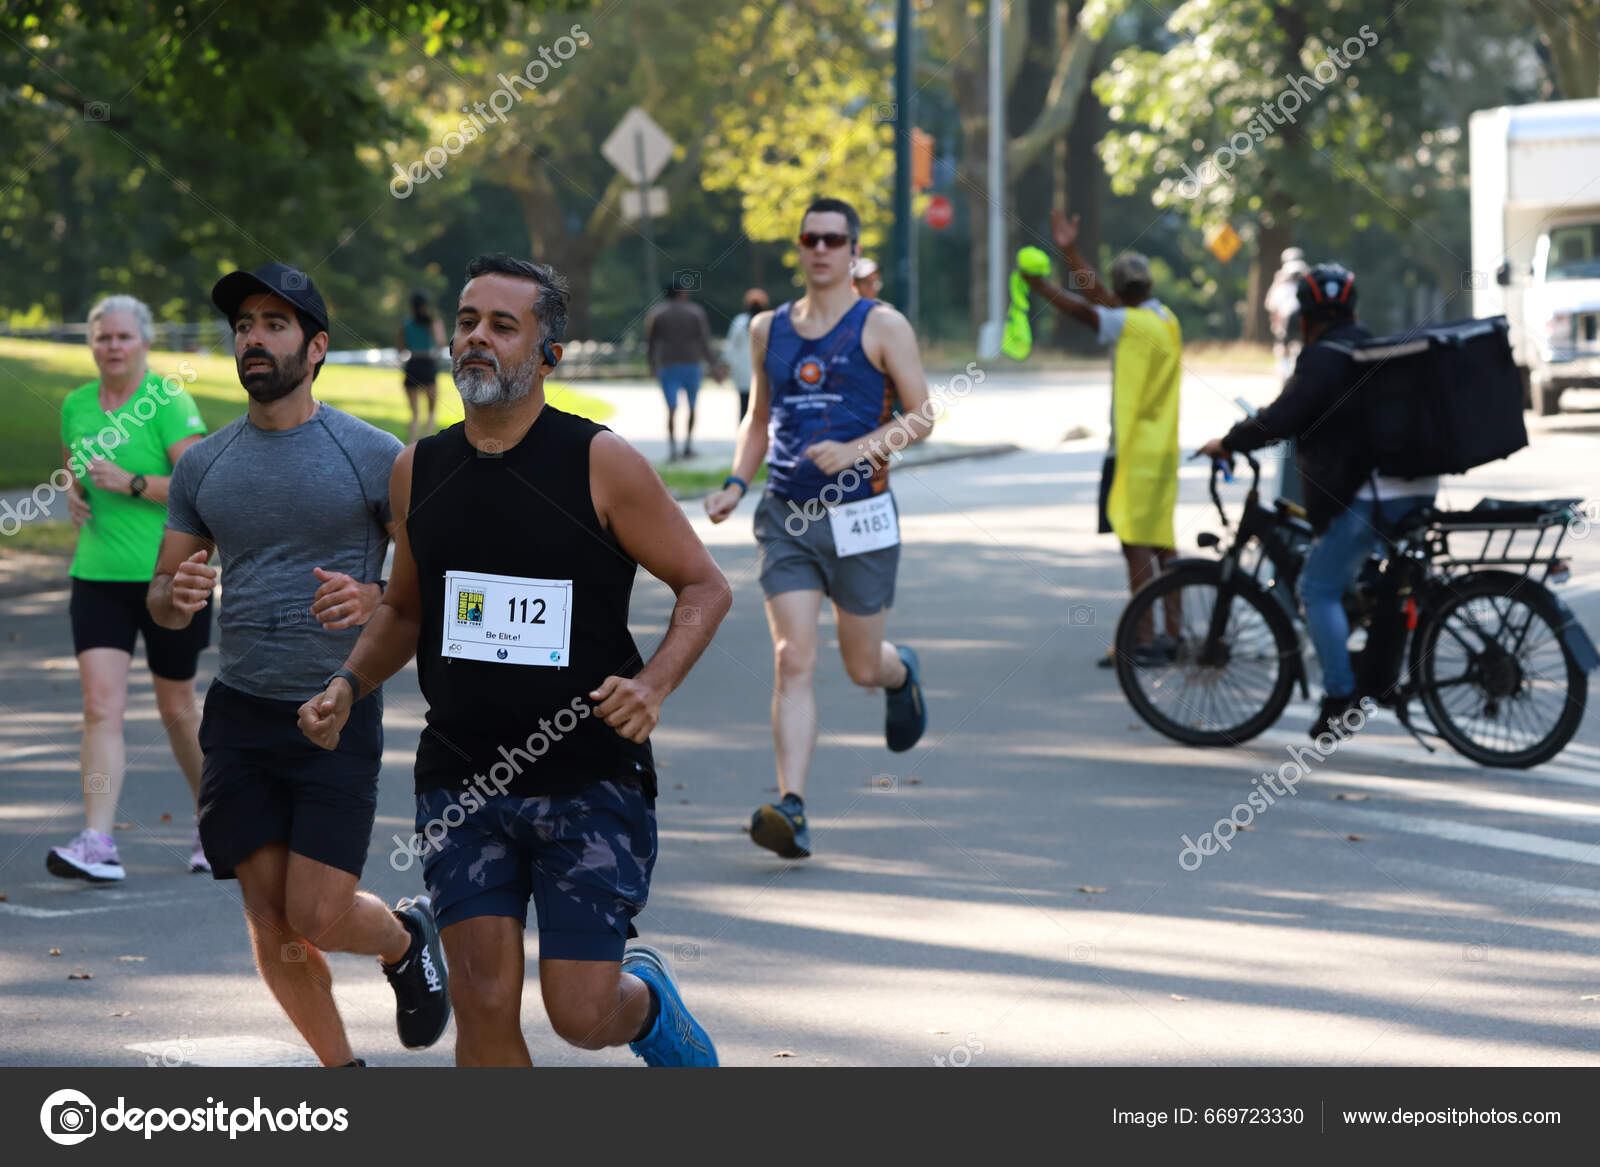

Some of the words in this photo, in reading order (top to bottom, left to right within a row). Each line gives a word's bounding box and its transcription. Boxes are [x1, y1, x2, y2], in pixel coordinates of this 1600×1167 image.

[850, 512, 890, 536] 4183
[459, 592, 469, 620] COMIC
[468, 593, 483, 603] RUN
[508, 597, 546, 625] 112
[485, 631, 497, 640] Be
[499, 632, 521, 641] Elite!
[421, 944, 442, 992] HOKA
